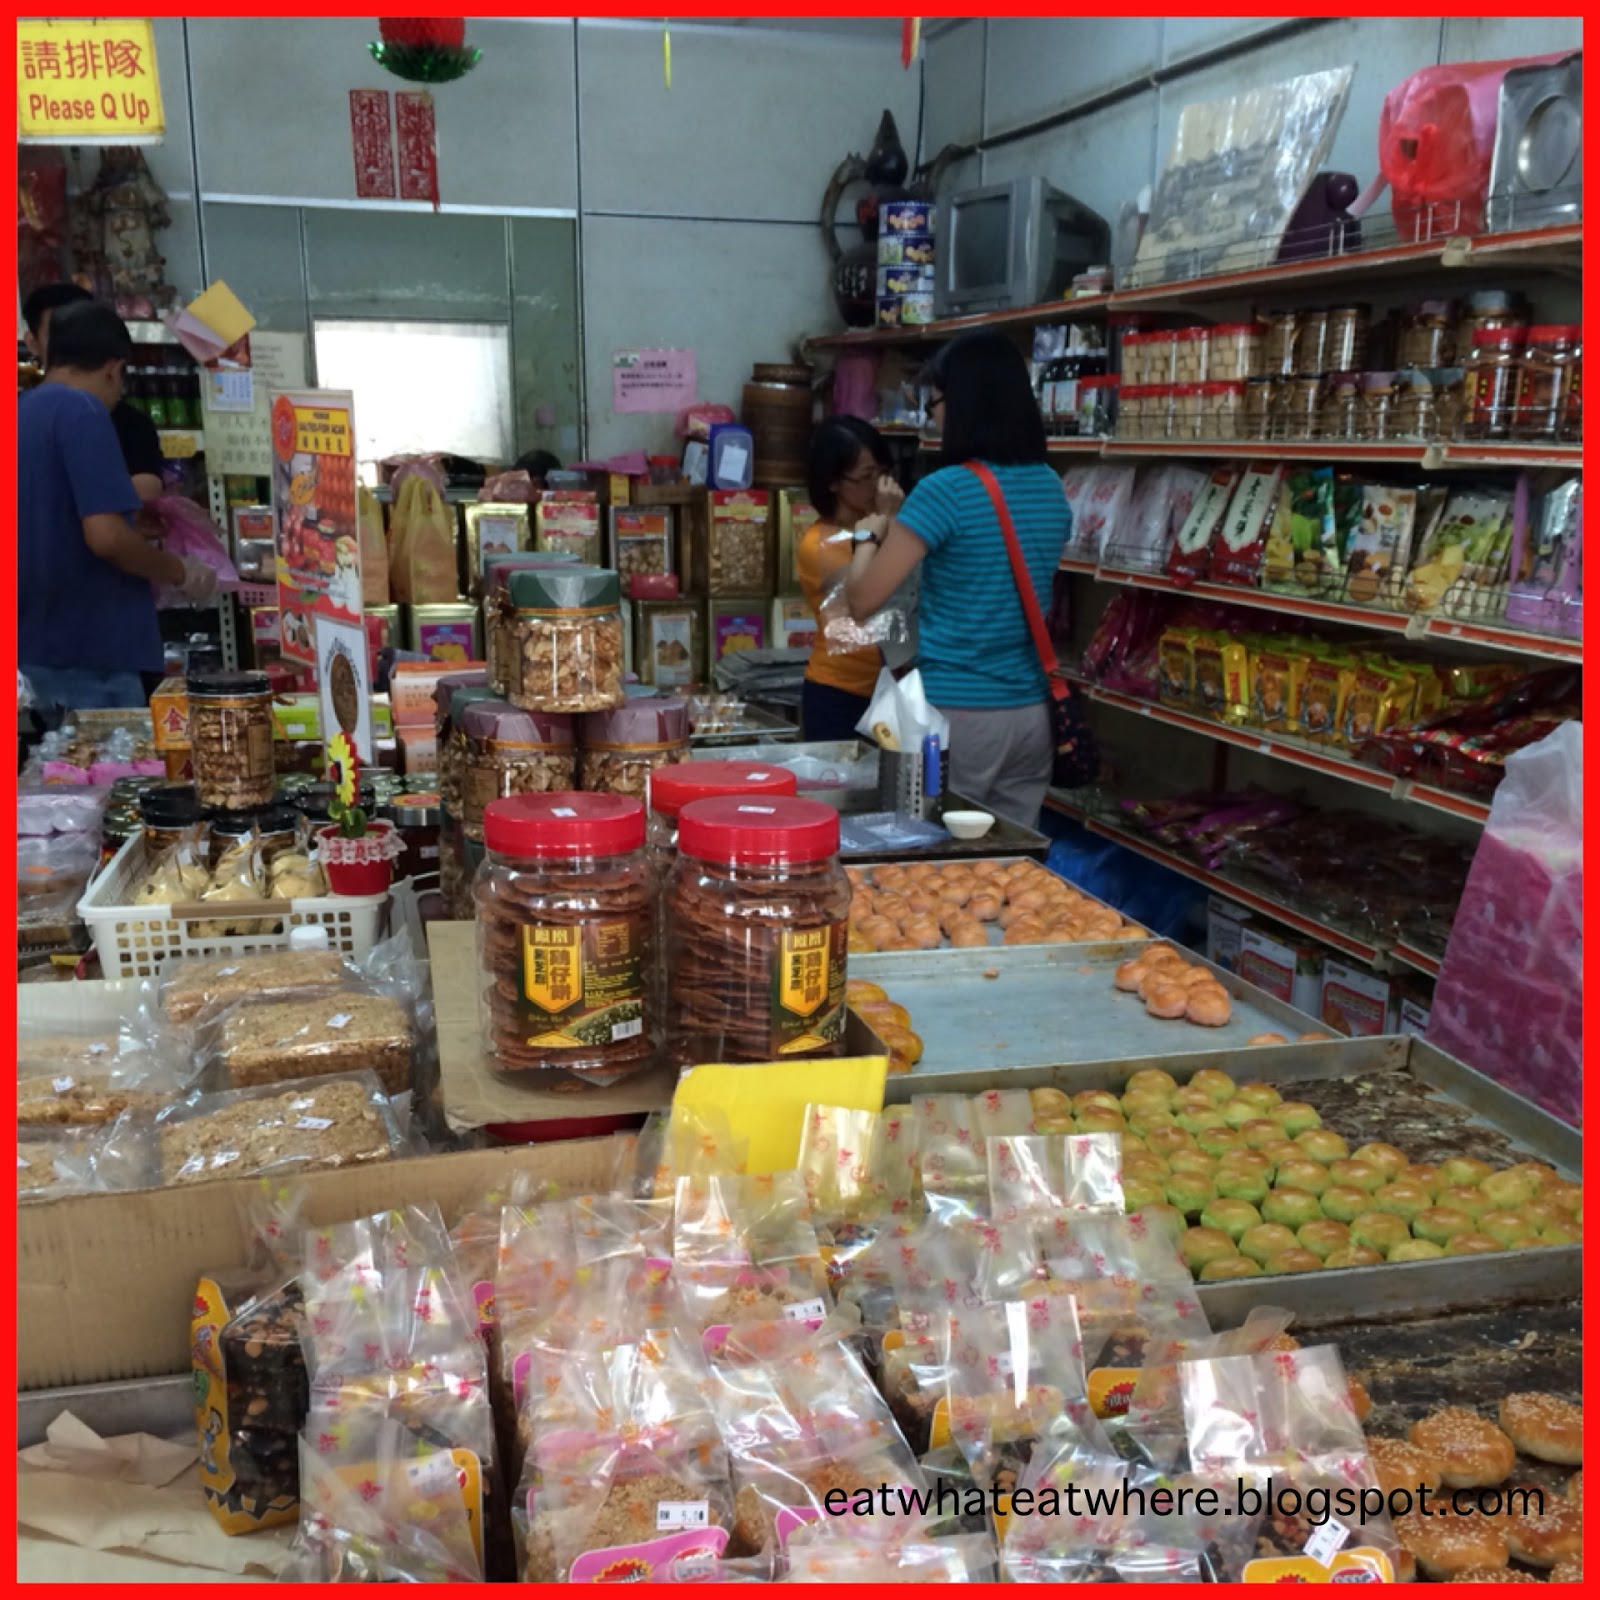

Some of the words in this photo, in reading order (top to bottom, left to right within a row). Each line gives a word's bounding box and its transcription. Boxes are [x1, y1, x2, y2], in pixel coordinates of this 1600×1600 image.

[21, 39, 146, 80] 請排隊
[29, 93, 95, 120] Please
[101, 92, 118, 120] Q
[121, 92, 150, 125] Up
